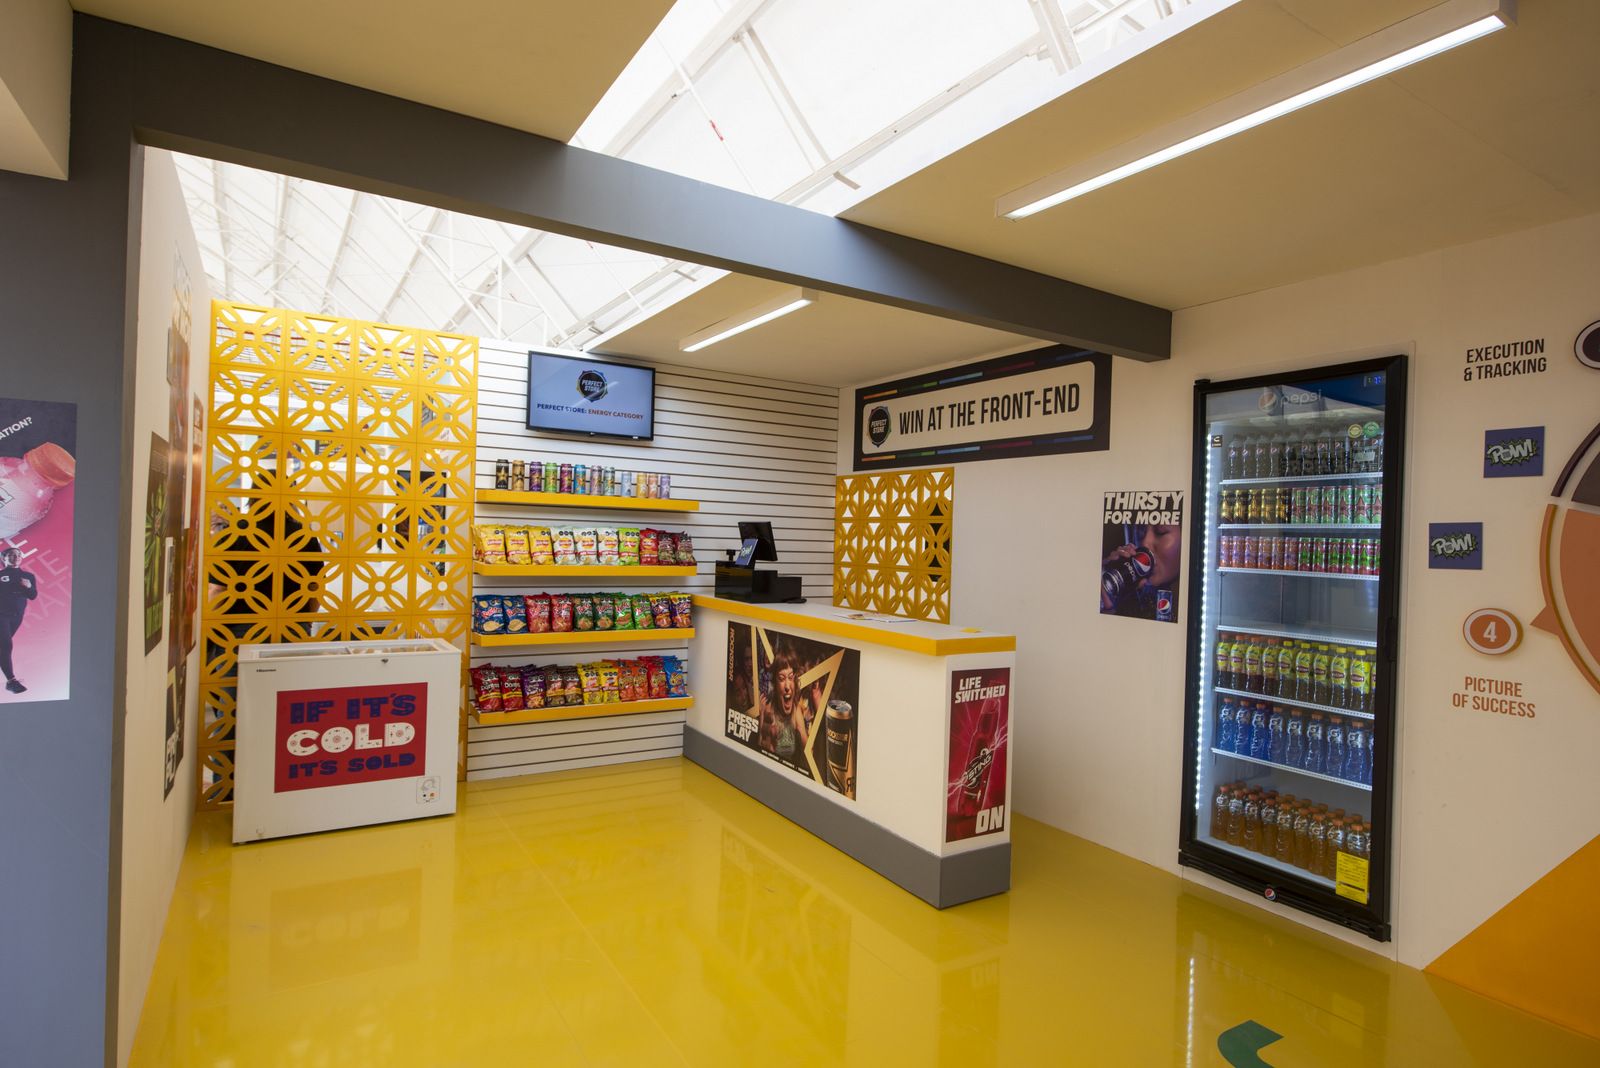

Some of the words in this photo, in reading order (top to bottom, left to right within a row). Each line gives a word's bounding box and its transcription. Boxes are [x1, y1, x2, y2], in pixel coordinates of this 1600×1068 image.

[1466, 338, 1545, 364] EXECUTION
[1463, 367, 1473, 382] &
[1476, 357, 1547, 380] TRACKING
[537, 403, 564, 412] PERFECT
[565, 405, 587, 414] STORE:
[588, 408, 613, 417] ENERGY
[612, 411, 644, 420] CATEGORY
[899, 408, 924, 435] WIN
[928, 405, 944, 431] AT
[948, 400, 975, 428] THE
[980, 383, 1080, 424] FRONT-END
[1486, 438, 1534, 463] POW!
[1104, 491, 1184, 511] THIRSTY
[1104, 511, 1132, 524] FOR
[1136, 510, 1180, 526] MORE
[1431, 533, 1474, 555] POW!
[1482, 621, 1497, 642] 4
[954, 684, 1006, 704] SWITCHED
[960, 676, 982, 691] LIFE
[1464, 676, 1522, 698] PICTURE
[290, 700, 334, 724] IF
[346, 693, 417, 720] IT'S
[1452, 692, 1470, 708] OF
[1472, 694, 1536, 718] SUCCESS
[727, 722, 752, 743] PLAY
[728, 708, 759, 733] PRESS
[286, 722, 416, 757] COLD
[288, 760, 338, 780] IT'S
[348, 752, 416, 774] SOLD
[967, 752, 992, 779] STING
[975, 805, 1004, 835] ON
